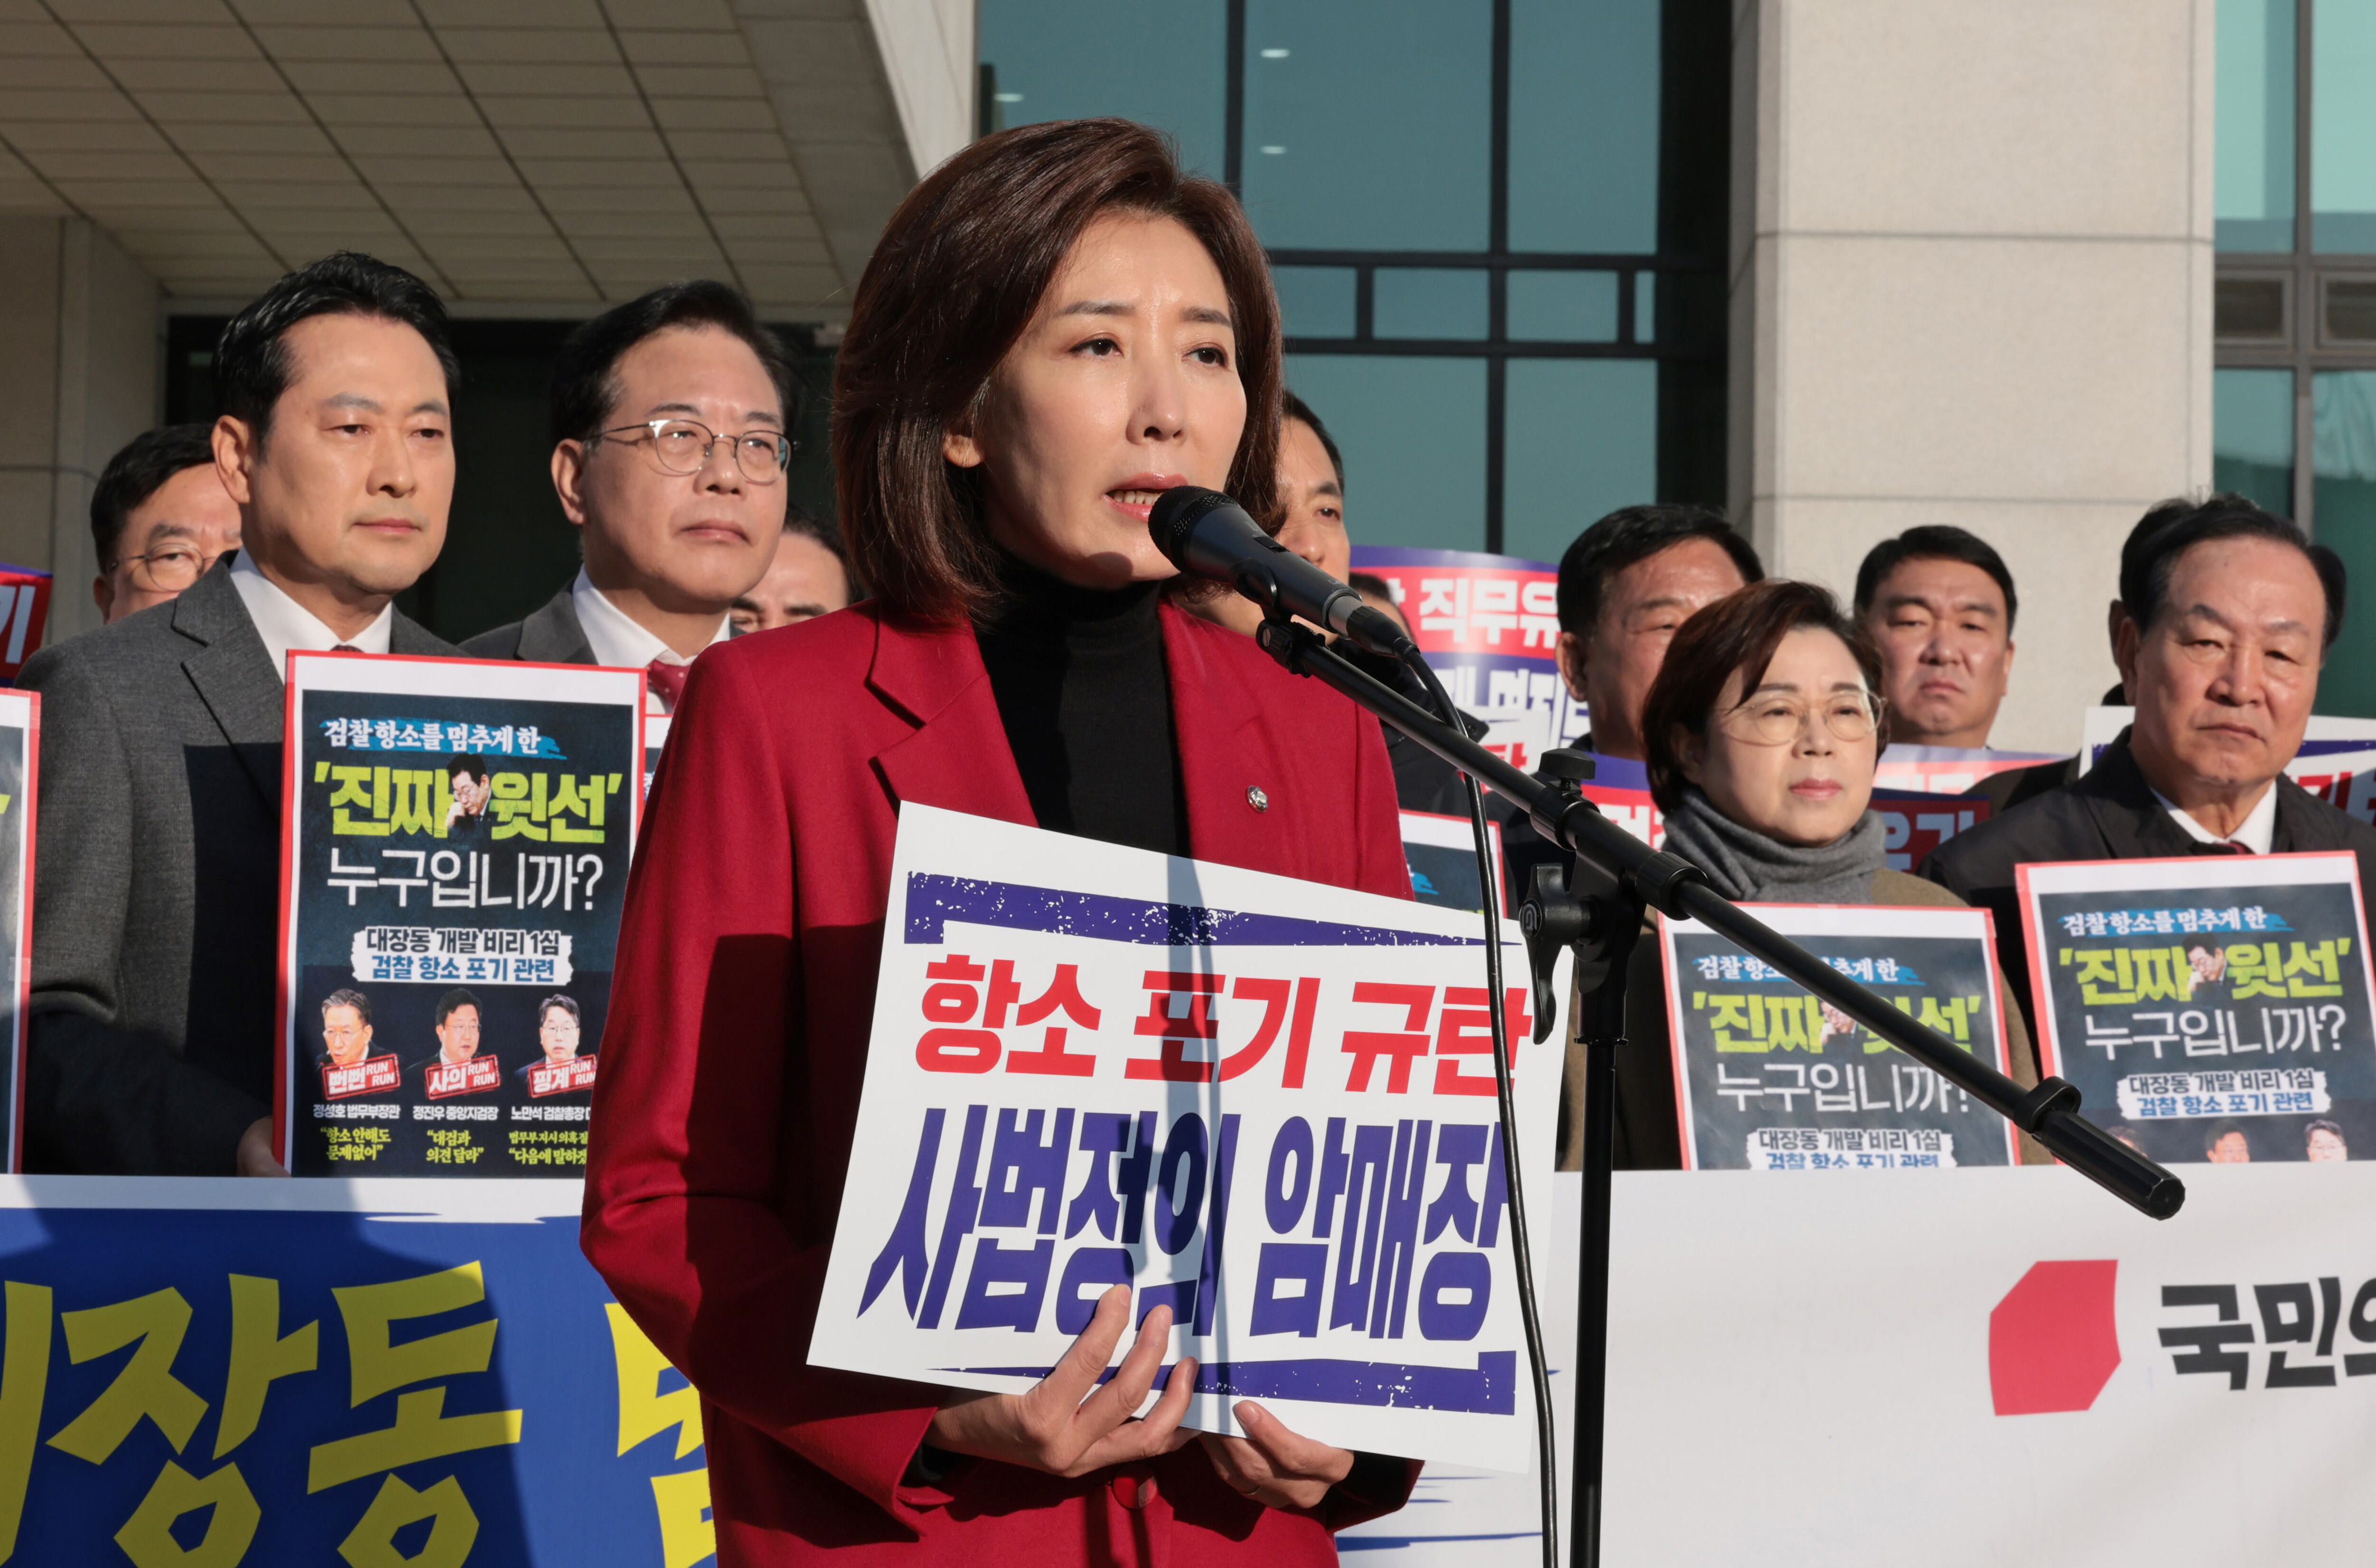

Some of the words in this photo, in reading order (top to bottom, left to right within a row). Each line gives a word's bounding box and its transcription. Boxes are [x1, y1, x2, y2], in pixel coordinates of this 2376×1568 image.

[324, 717, 373, 748] 검찰
[374, 720, 444, 750] 항소를
[447, 722, 514, 753] 멈추게
[516, 726, 541, 754] 한
[314, 762, 451, 838] '진짜
[489, 772, 622, 843] 윗선'
[328, 848, 604, 910] 누구입니까?
[2064, 912, 2107, 937] 검찰
[2109, 910, 2175, 935] 항소를
[2176, 907, 2242, 933] 멈추게
[2242, 905, 2268, 929] 한
[366, 928, 432, 953] 대장동
[436, 929, 478, 954] 개발
[484, 930, 525, 955] 비리
[530, 931, 559, 955] 1심
[372, 955, 413, 980] 검찰
[419, 956, 460, 980] 항소
[466, 957, 507, 981] 포기
[514, 958, 555, 983] 관련
[1698, 955, 1742, 980] 검찰
[1875, 957, 1900, 982] 한
[2060, 946, 2193, 1006] '진짜
[2225, 938, 2351, 1000] 윗선'
[915, 953, 1102, 1078] 항소
[1124, 970, 1321, 1089] 포기
[1340, 981, 1533, 1097] 규탄
[1693, 992, 1824, 1055] '진짜
[2085, 1005, 2347, 1061] 누구입니까?
[366, 1062, 388, 1076] RUN
[371, 1072, 395, 1087] RUN
[429, 1066, 466, 1093] 사의
[467, 1062, 489, 1076] RUN
[473, 1072, 496, 1087] RUN
[533, 1066, 569, 1093] 핑계
[570, 1061, 590, 1075] RUN
[2129, 1075, 2190, 1094] 대장동
[2194, 1073, 2235, 1092] 개발
[2239, 1071, 2279, 1090] 비리
[2284, 1069, 2314, 1089] 1심
[314, 1105, 346, 1118] 정성호
[347, 1105, 401, 1119] 법무부장관
[413, 1106, 445, 1120] 정진우
[446, 1106, 499, 1120] 중앙지검장
[511, 1106, 542, 1121] 노만석
[544, 1106, 585, 1121] 검찰총장
[2138, 1096, 2177, 1116] 검찰
[2182, 1095, 2223, 1115] 항소
[2228, 1093, 2269, 1112] 포기
[2274, 1092, 2314, 1111] 관련
[352, 1127, 391, 1144] 안해도
[509, 1131, 538, 1144] 법무부
[539, 1131, 557, 1144] 지시
[1759, 1130, 1819, 1151] 대장동
[1824, 1130, 1864, 1151] 개발
[1868, 1130, 1908, 1151] 비리
[1912, 1130, 1942, 1152] 1심
[426, 1147, 451, 1163] 의견
[1766, 1153, 1806, 1170] 검찰
[855, 1103, 1241, 1337] 사법정의
[1249, 1115, 1508, 1342] 암매장
[0, 1260, 523, 1568] 장동
